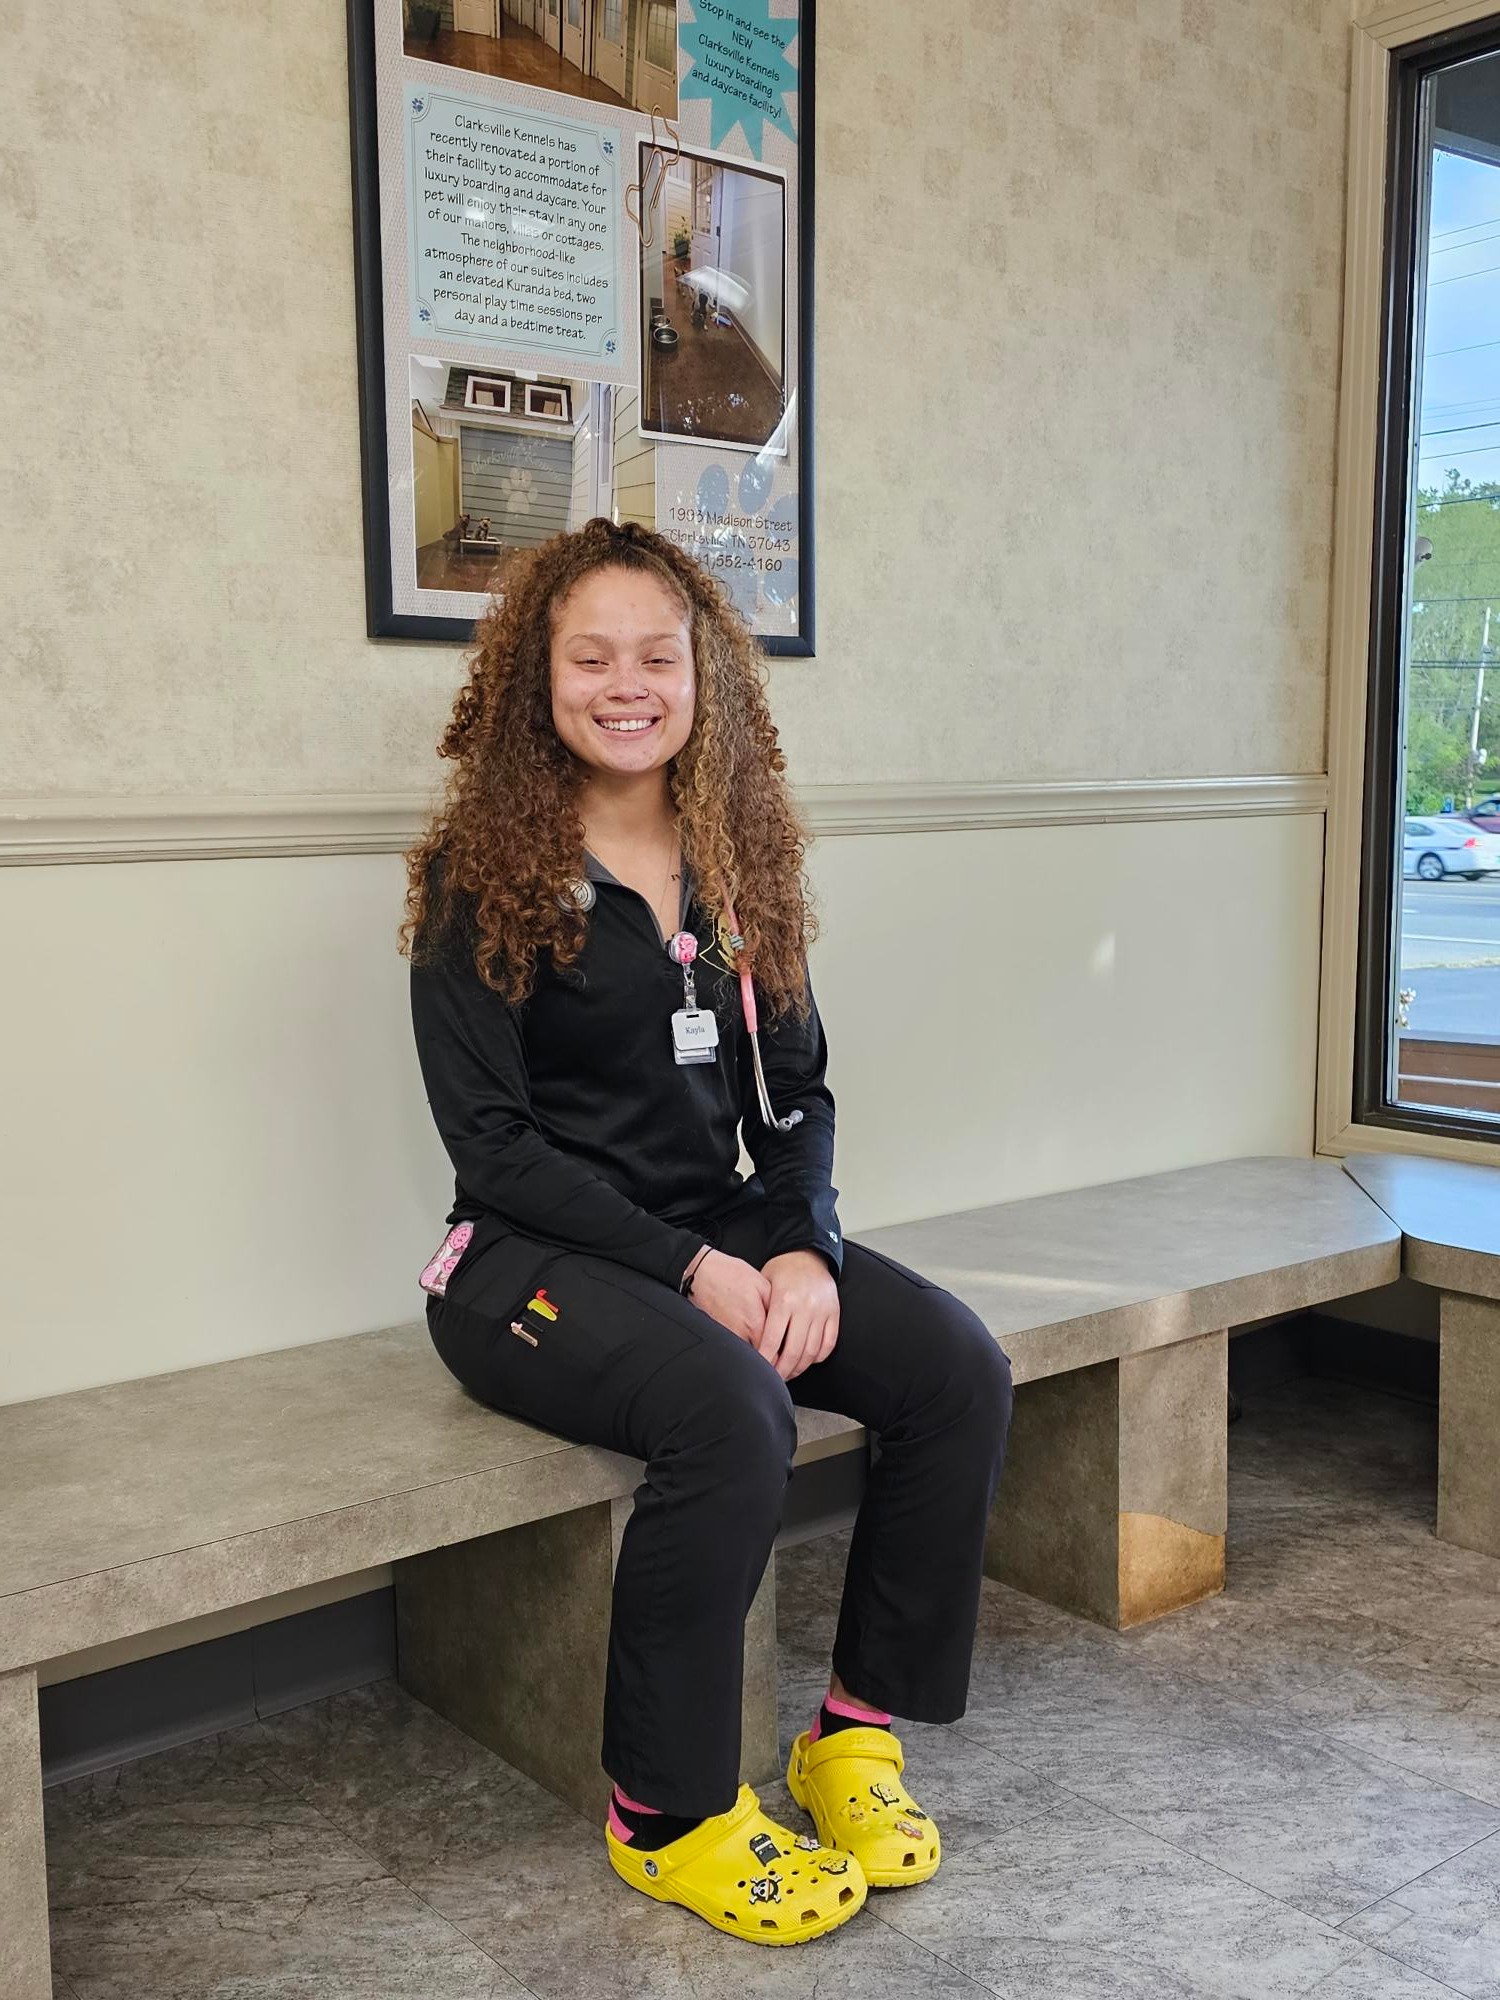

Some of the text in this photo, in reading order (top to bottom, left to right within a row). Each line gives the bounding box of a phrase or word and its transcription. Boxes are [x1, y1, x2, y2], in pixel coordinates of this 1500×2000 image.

[700, 0, 786, 49] Stop in and see the
[732, 30, 753, 50] NEW
[698, 33, 780, 81] Clarksville Kennels
[705, 54, 773, 98] luxury boarding
[692, 69, 782, 119] and daycare facility!
[455, 115, 576, 152] Clarksville Kennels has
[425, 149, 607, 196] their facility to accommodate for
[430, 132, 600, 176] recently renovated a portion of
[424, 167, 606, 214] luxury boarding and daycare. Your
[425, 190, 607, 233] pet will enjoy their stay in any one
[428, 208, 441, 219] of
[443, 213, 462, 223] our
[542, 232, 553, 240] or
[556, 234, 604, 251] cottages.
[425, 248, 609, 288] atmosphere of our suites includes
[460, 233, 575, 264] The neighborhood-like
[433, 288, 603, 326] personal play time sessions per
[439, 270, 596, 304] an elevated Kuranda bed, two
[455, 308, 586, 340] day and a bedtime treat.
[669, 507, 792, 531] 1993 Madison Street
[731, 534, 746, 549] TN
[748, 536, 791, 552] 37043
[685, 1025, 706, 1036] Kayla
